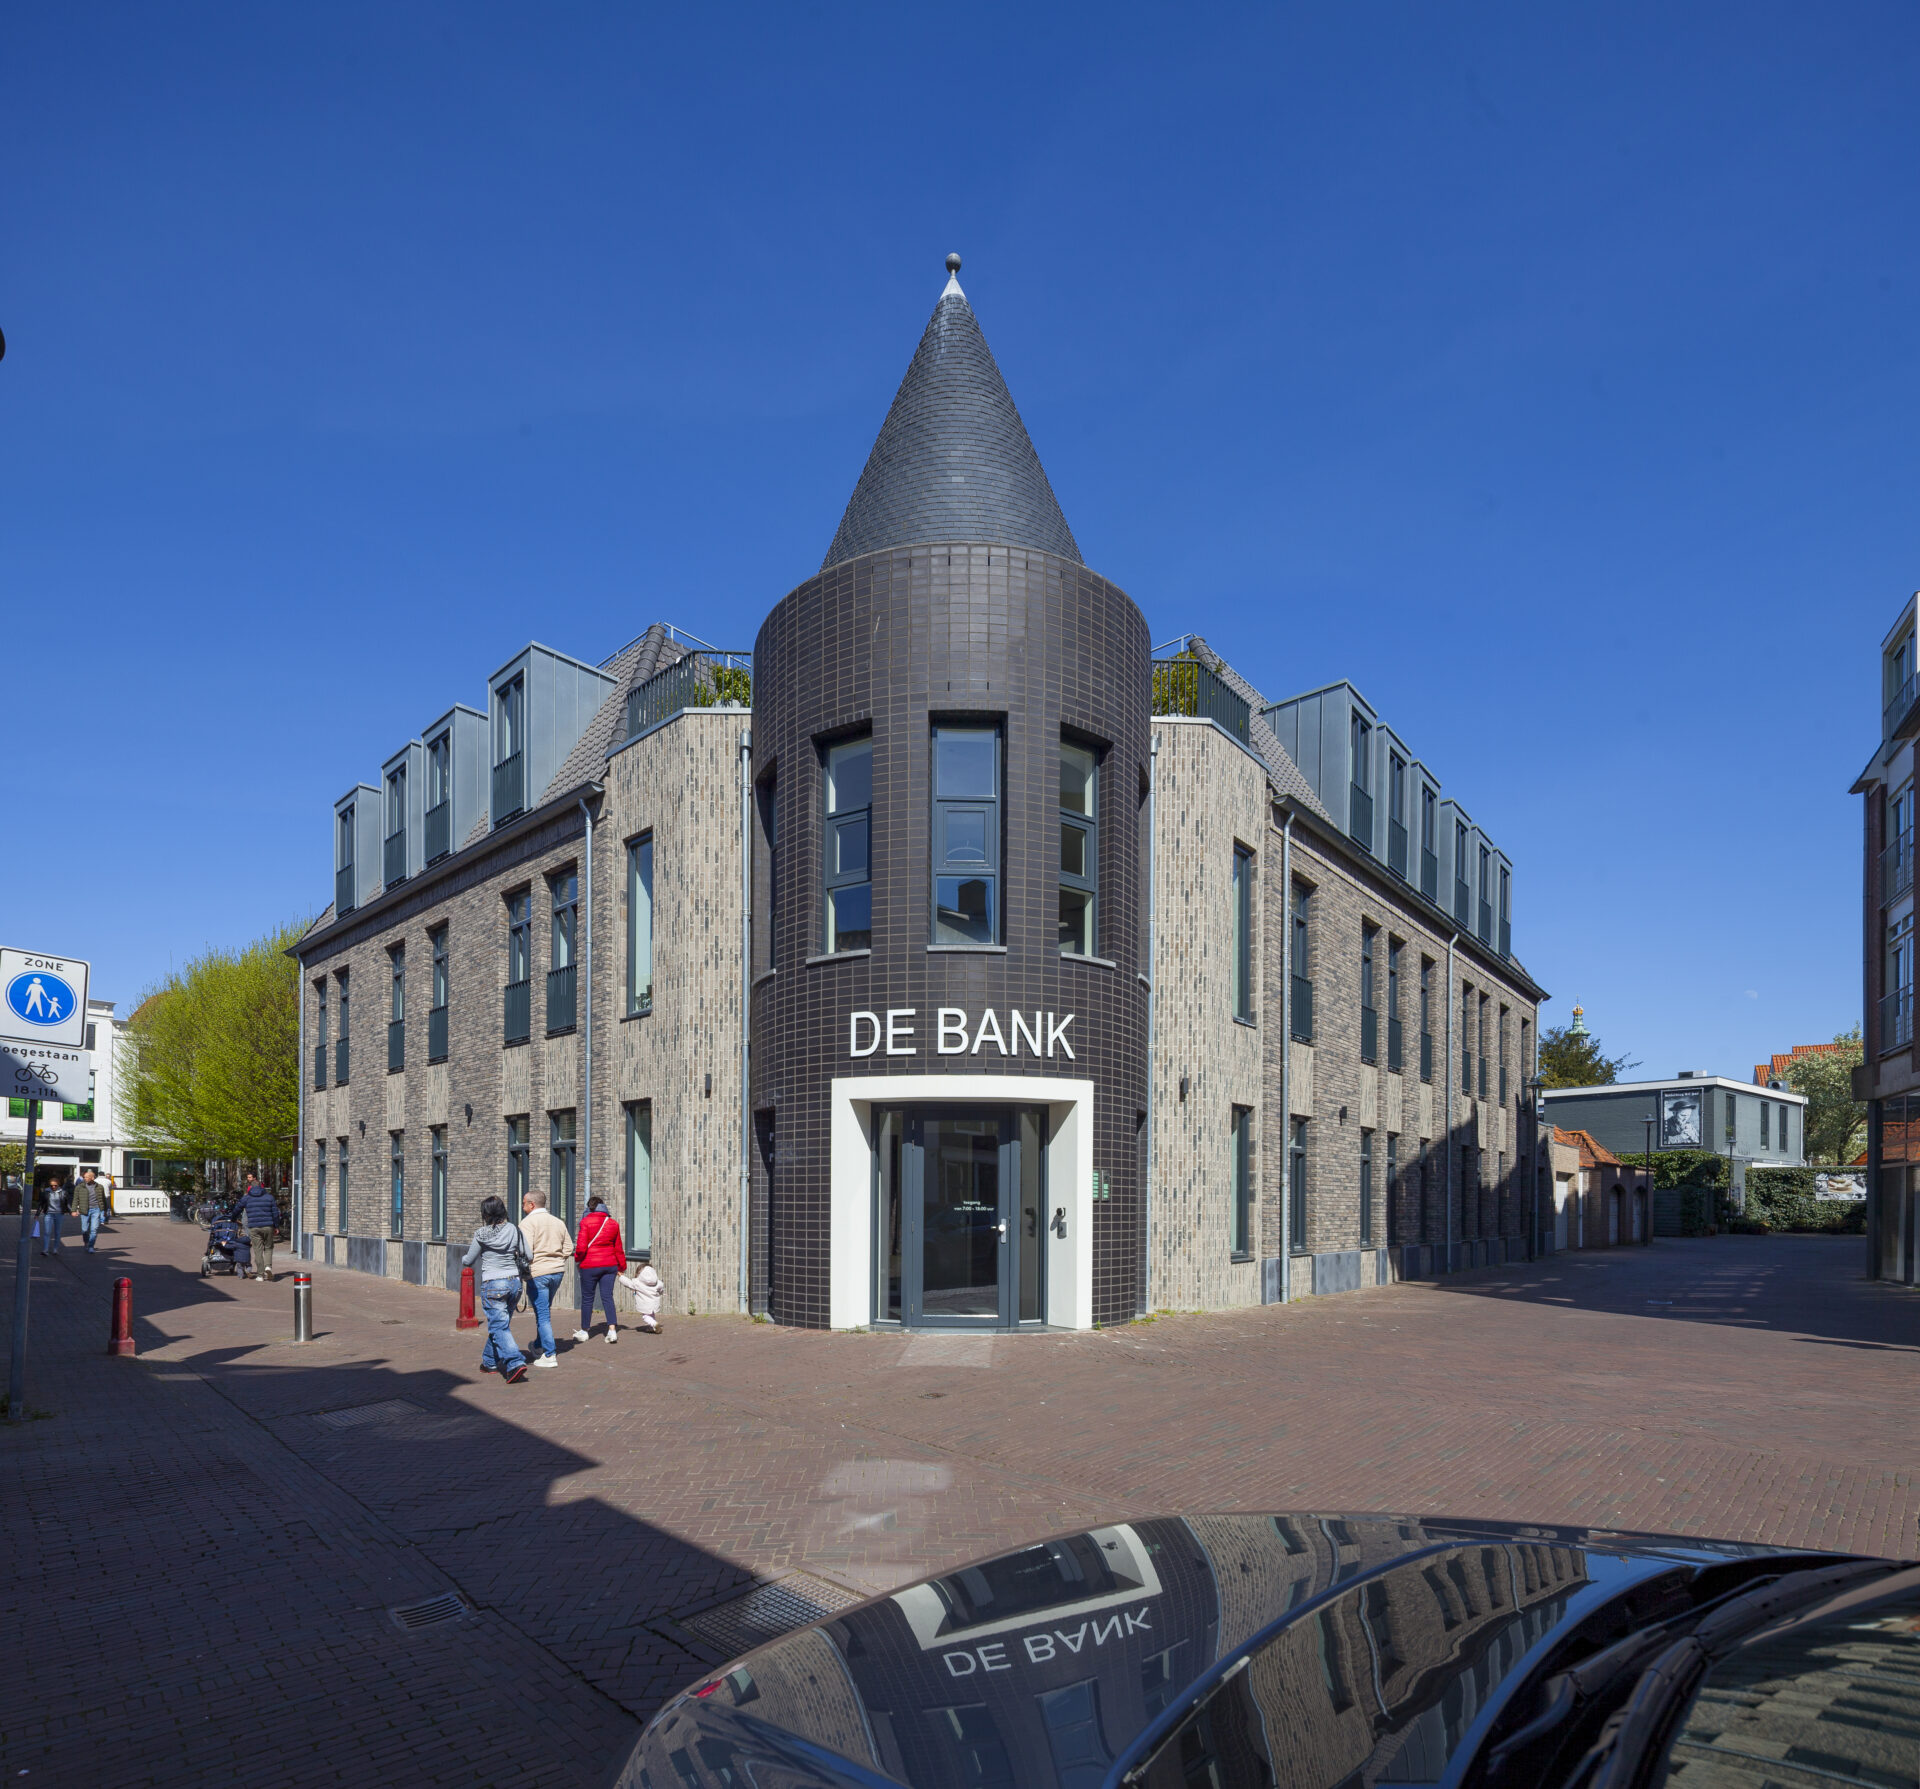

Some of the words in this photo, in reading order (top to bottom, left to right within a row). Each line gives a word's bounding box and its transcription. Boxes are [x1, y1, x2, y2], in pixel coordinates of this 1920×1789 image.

[24, 957, 64, 971] ZONE
[850, 1008, 917, 1057] DE
[937, 1007, 1076, 1059] BANK
[0, 1046, 79, 1061] oegestaan
